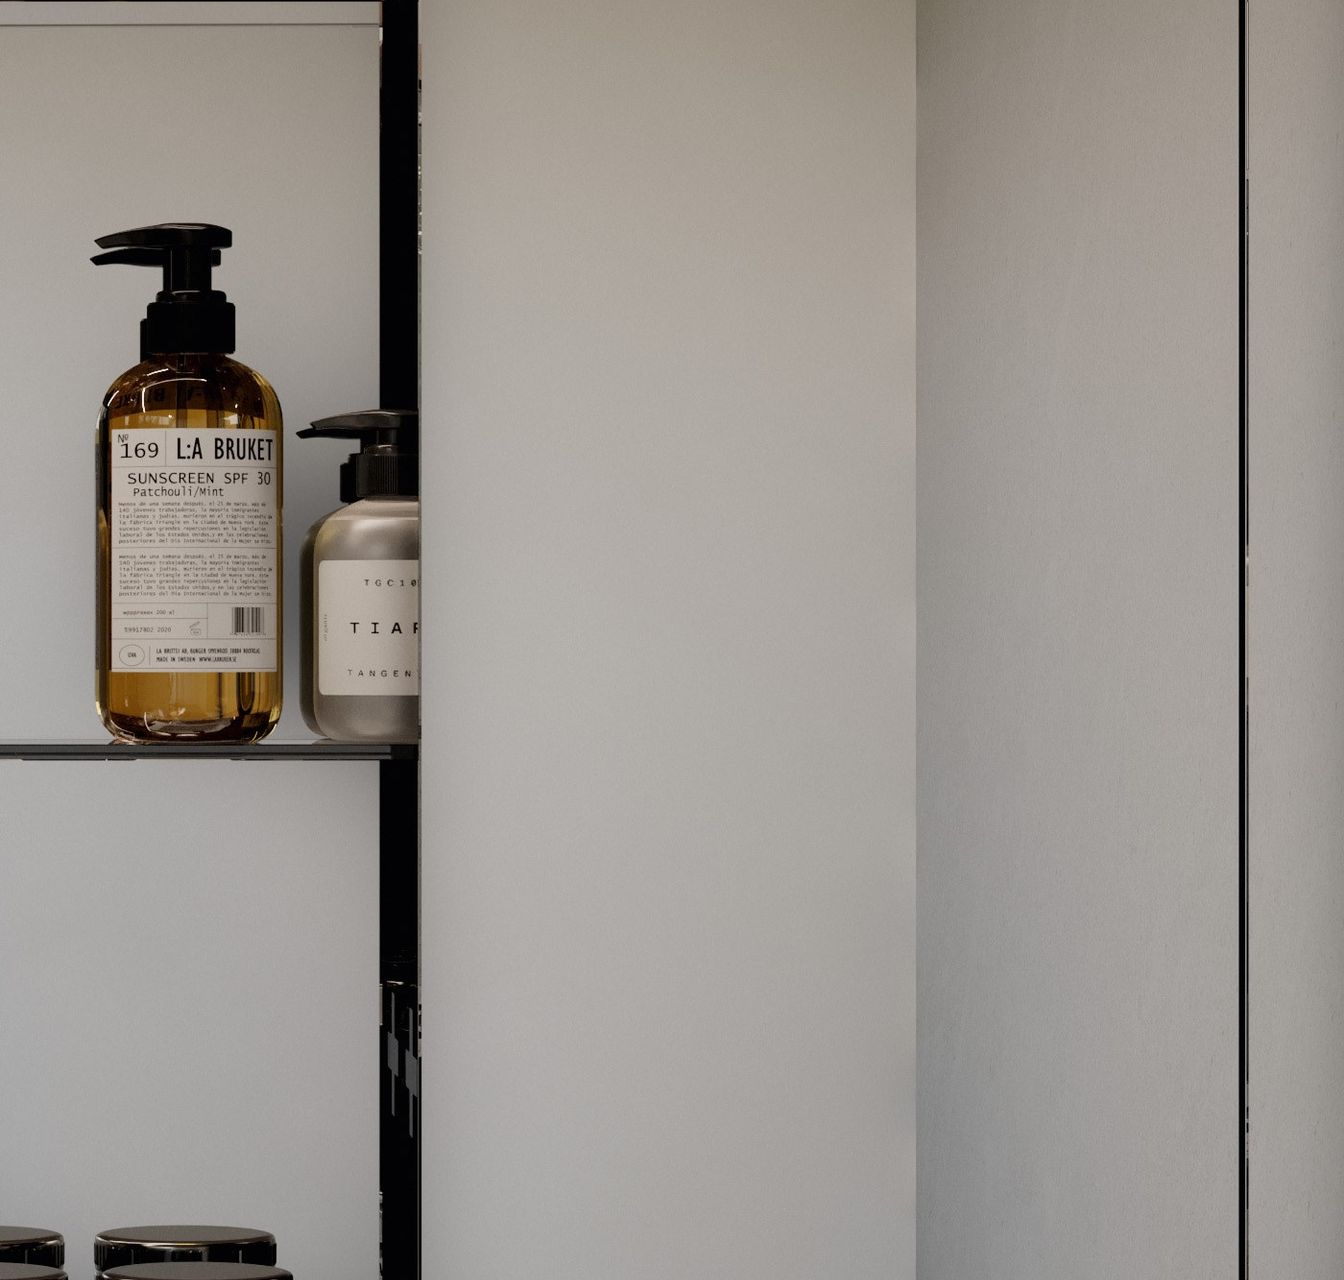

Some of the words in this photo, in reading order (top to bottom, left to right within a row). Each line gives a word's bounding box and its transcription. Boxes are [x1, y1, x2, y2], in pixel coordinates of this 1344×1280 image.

[120, 442, 159, 459] 169
[177, 437, 203, 460] L:A
[214, 437, 273, 461] BRUKET
[127, 472, 215, 485] SUNSCREEN
[224, 472, 249, 485] SPF
[257, 471, 271, 485] 30
[133, 486, 225, 498] Patchouli/Mint
[364, 579, 419, 587] TGC10
[347, 669, 420, 679] TANGEN
